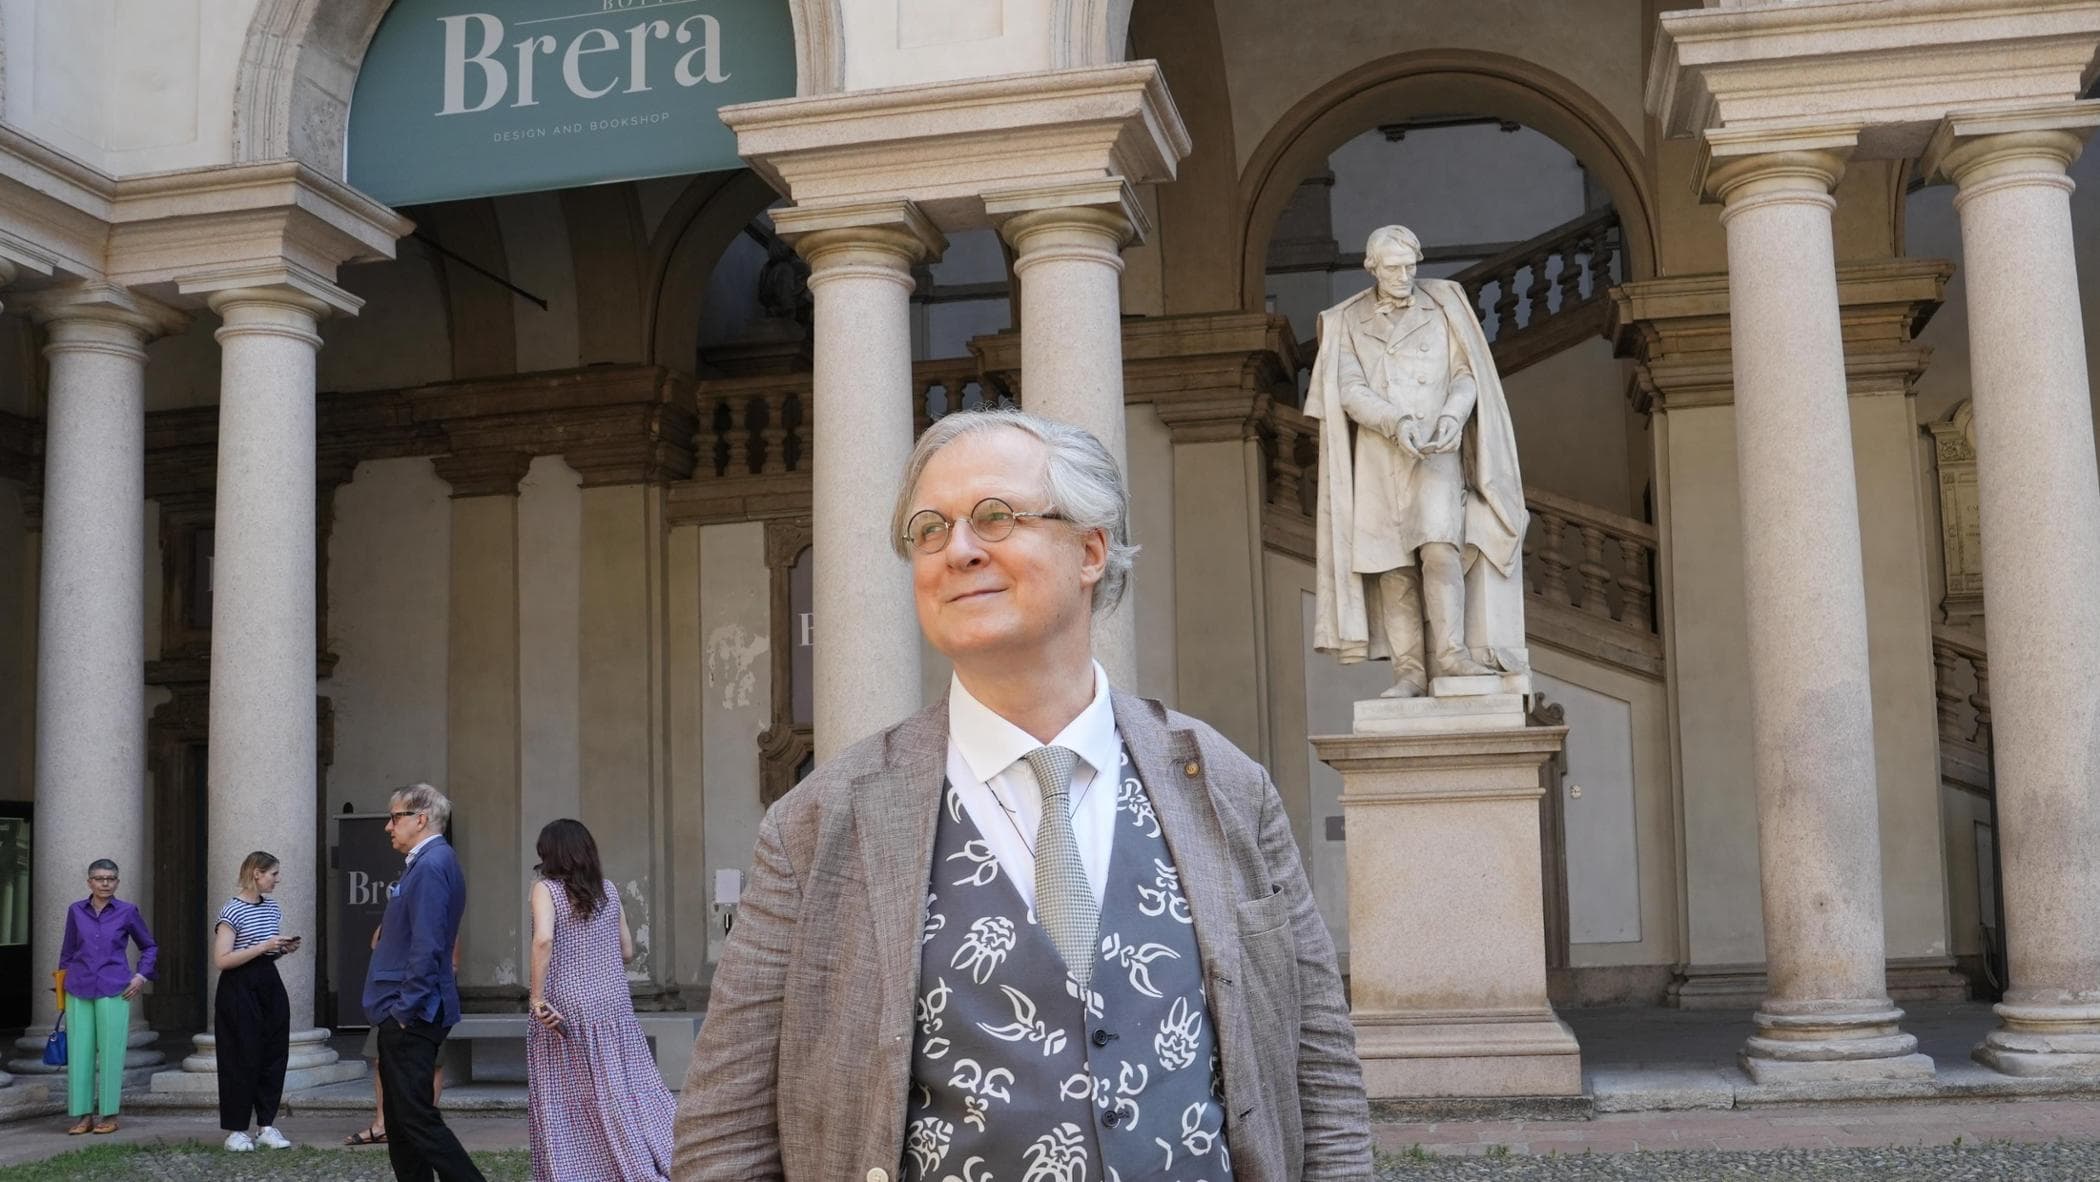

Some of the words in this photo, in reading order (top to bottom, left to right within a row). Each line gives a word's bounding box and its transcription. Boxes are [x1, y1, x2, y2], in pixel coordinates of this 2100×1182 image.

[434, 13, 732, 117] Brera
[494, 127, 546, 142] DESIGN
[552, 123, 582, 136] AND
[590, 112, 670, 131] BOOKSHOP
